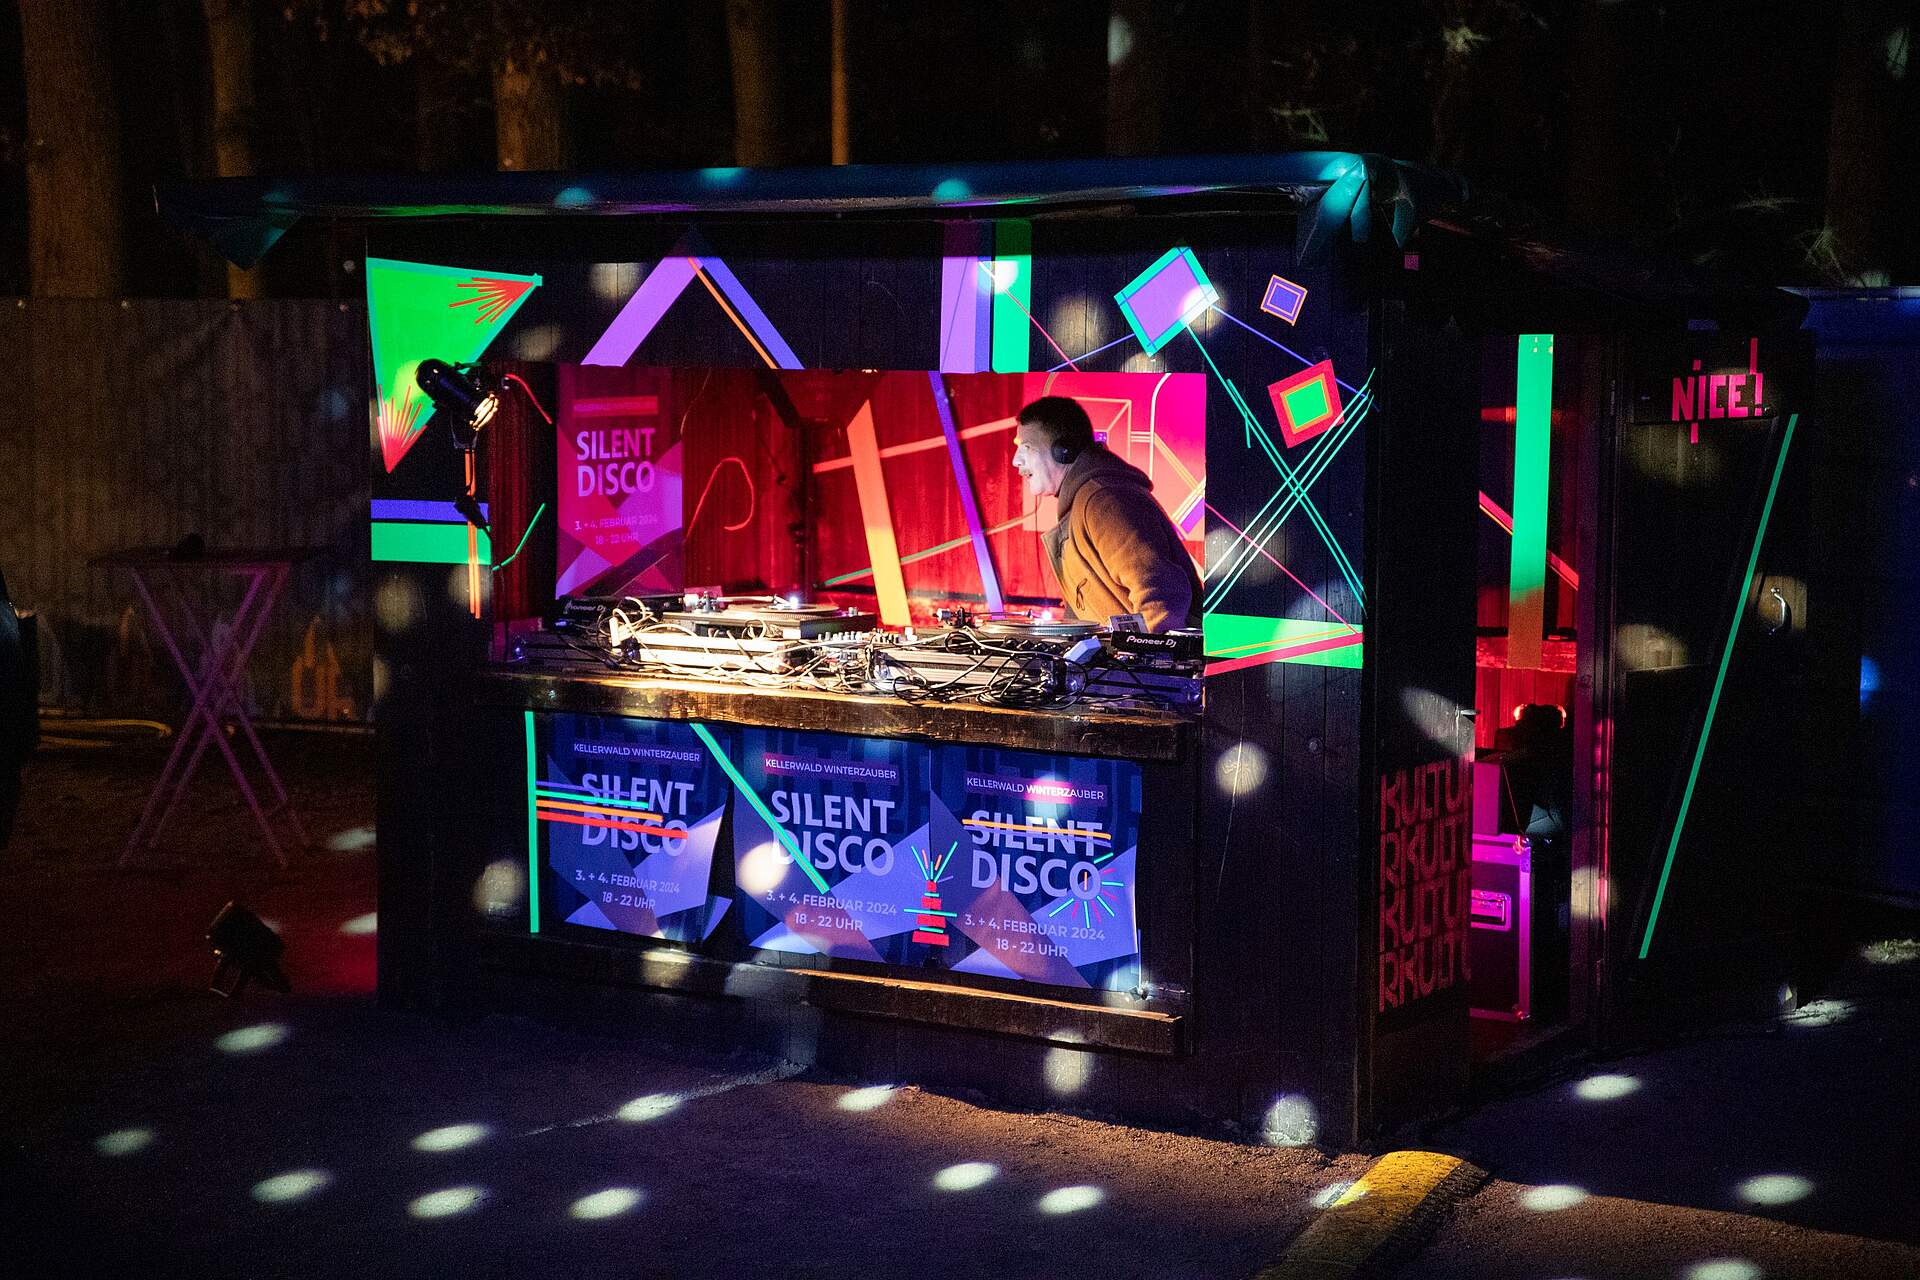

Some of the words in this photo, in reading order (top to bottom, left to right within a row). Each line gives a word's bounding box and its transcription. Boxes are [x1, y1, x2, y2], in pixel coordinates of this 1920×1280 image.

[576, 428, 655, 461] SILENT
[577, 461, 655, 497] DISCO
[1126, 635, 1164, 645] Pioneer
[574, 743, 630, 756] KELLERWALD
[631, 748, 700, 762] WINTERZAUBER
[766, 759, 823, 773] KELLERWALD
[823, 765, 896, 780] WINTERZAUBER
[582, 773, 695, 816] SILENT
[967, 777, 1024, 793] KELLERWALD
[1026, 784, 1104, 800] WINTERZAUBER
[771, 790, 895, 834] SILENT
[582, 811, 688, 857] DISCO
[971, 810, 1103, 856] SILENT
[772, 828, 894, 877] DISCO
[576, 869, 585, 881] 3.
[598, 872, 608, 884] 4.
[611, 874, 657, 891] FEBRUAR
[658, 881, 680, 893] 2024
[971, 850, 1102, 901] DISCO
[602, 891, 613, 903] 18
[620, 894, 632, 906] 22
[634, 896, 656, 910] UHR
[766, 889, 776, 901] 3.
[789, 892, 800, 904] 4.
[803, 894, 863, 912] FEBRUAR
[866, 901, 897, 916] 2024
[795, 912, 807, 925] 18
[818, 915, 832, 928] 22
[835, 917, 863, 931] UHR
[964, 913, 975, 926] 3.
[988, 917, 1000, 930] 4.
[1003, 919, 1067, 937] FEBRUAR
[1071, 926, 1106, 941] 2024
[996, 937, 1009, 951] 18
[1020, 941, 1035, 954] 22
[1038, 943, 1068, 958] UHR
